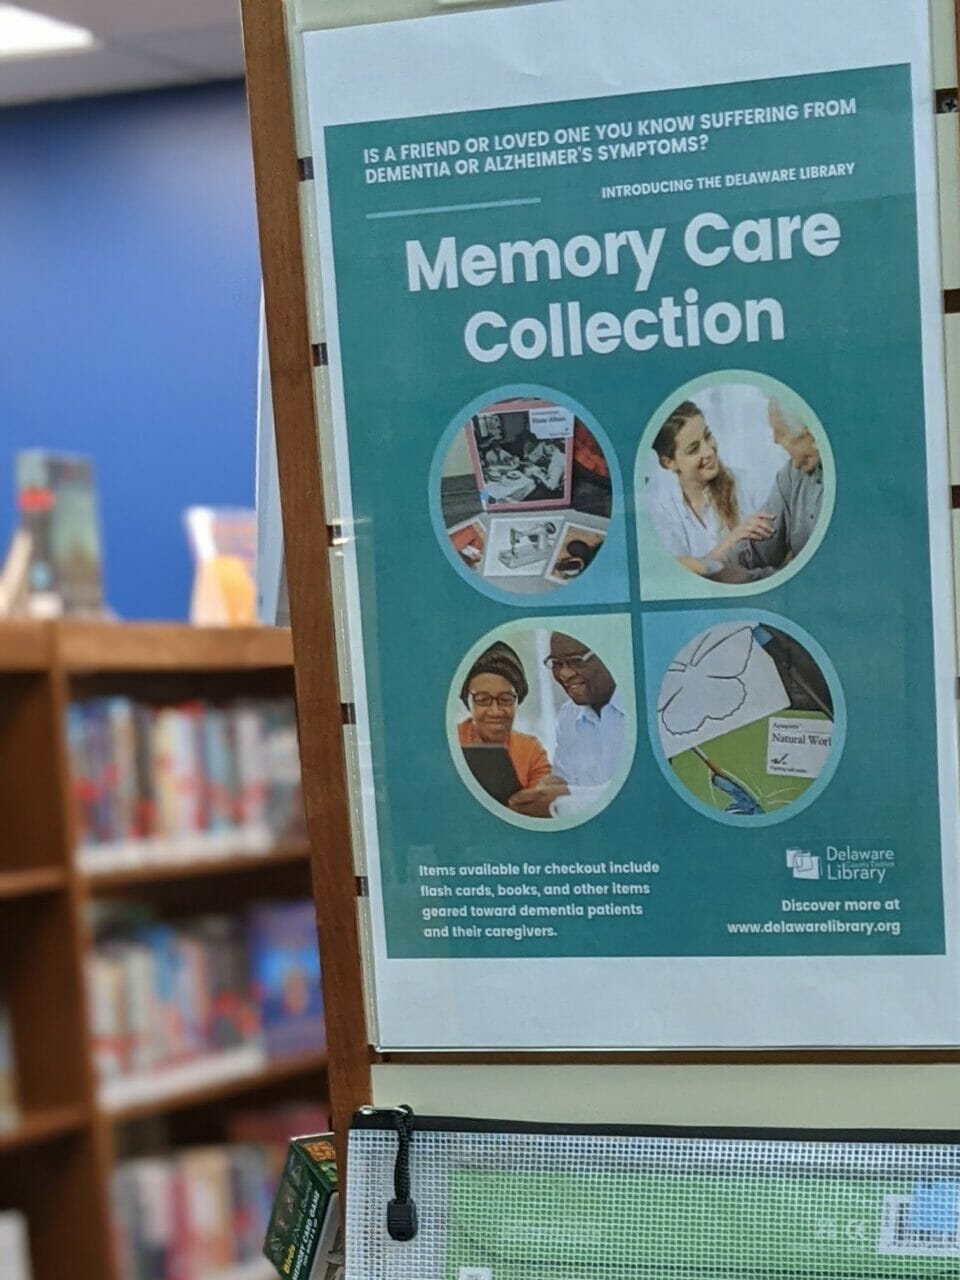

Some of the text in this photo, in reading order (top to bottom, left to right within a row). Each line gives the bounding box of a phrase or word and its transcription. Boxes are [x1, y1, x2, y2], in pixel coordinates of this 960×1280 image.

[363, 97, 857, 164] IS A FRIEND OR LOVED ONE YOU KNOW SUFFERING FROM
[365, 134, 710, 184] DEMENTIA OR ALZHEIMER'S SYMPTOMS?
[601, 162, 856, 199] INTRODUCING THE DELAWARE LIBRARY
[404, 210, 842, 292] Memory Care
[463, 287, 786, 363] Collection
[772, 732, 806, 745] Natural
[826, 845, 895, 861] Delaware
[419, 861, 660, 877] Items available for checkout include
[827, 864, 886, 883] Library
[420, 881, 650, 898] flash cards, books, and other items
[422, 903, 643, 921] geared toward dementia patients
[782, 898, 900, 912] Discover more at
[423, 924, 558, 940] and their caregivers.
[727, 919, 901, 936] www.delawarelibrary.org
